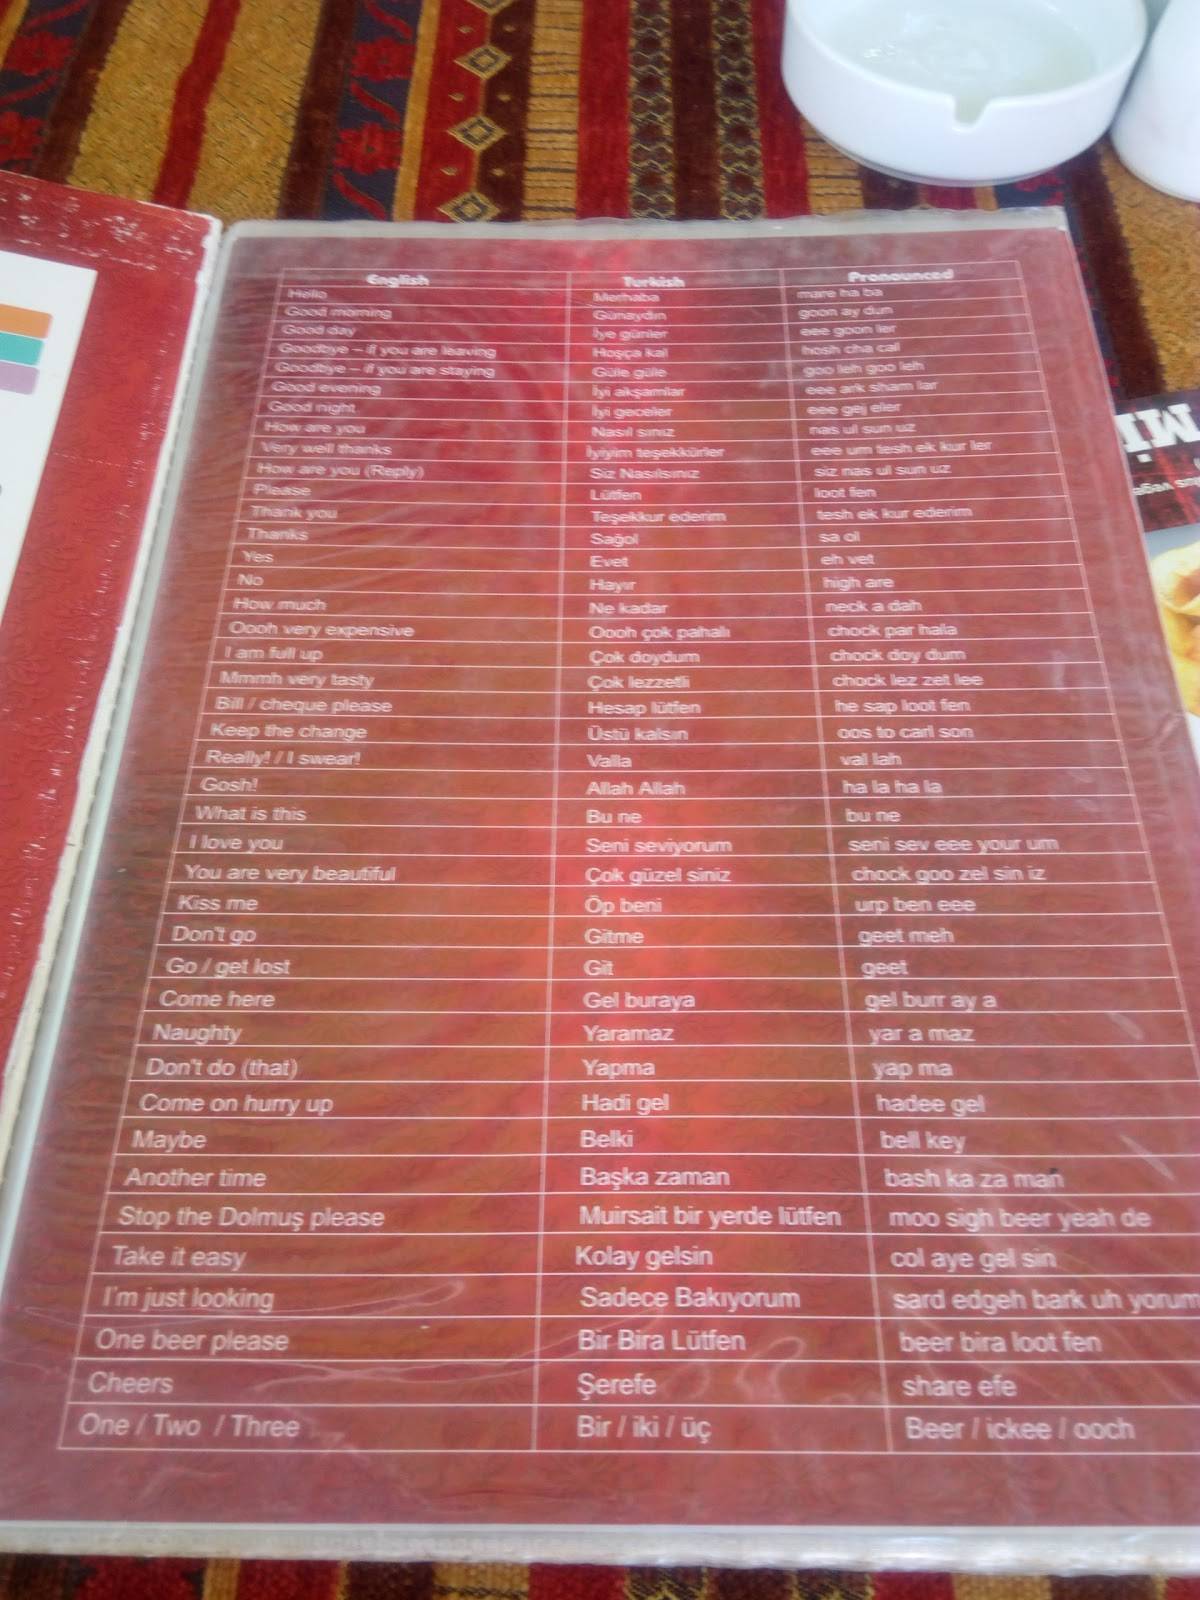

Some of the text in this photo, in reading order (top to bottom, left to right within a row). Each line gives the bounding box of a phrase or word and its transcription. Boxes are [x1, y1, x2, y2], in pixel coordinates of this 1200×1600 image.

[848, 268, 953, 283] Pronounced
[287, 288, 327, 300] Hello
[285, 306, 392, 320] Good morning
[282, 323, 356, 338] Good day
[271, 379, 381, 396] Good evening
[268, 399, 355, 415] Good night
[264, 420, 365, 436] How are you
[261, 441, 391, 456] Very well thanks
[257, 462, 423, 479] How are you (Reply)
[253, 482, 310, 497] Please
[251, 504, 337, 521] Thank you
[248, 526, 308, 542] Thanks
[243, 551, 274, 563] Yes
[236, 573, 264, 587] No
[823, 575, 894, 591] high are
[233, 596, 326, 612] How much
[229, 620, 414, 638] Oooh very expensive
[827, 623, 957, 638] chock par hala
[224, 645, 323, 662] I am full up
[220, 670, 374, 688] Mmmh very tasty
[211, 723, 367, 740] Keep the change
[200, 776, 257, 793] Gosh!
[586, 781, 685, 797] Allah Allah
[196, 805, 306, 822] What is this
[586, 808, 641, 825] Bu ne
[189, 834, 283, 851] I love you
[586, 837, 732, 854] Seni seviyorum
[185, 864, 395, 883] You are very beautiful
[585, 867, 730, 884] Çok güzel siniz
[178, 894, 258, 912] Kiss me
[585, 894, 662, 914] Öp beni
[172, 925, 256, 944] Don't go
[585, 928, 643, 945] Gitme
[858, 927, 953, 944] geet meh
[584, 959, 613, 977] Git
[862, 960, 908, 976] geet
[159, 989, 275, 1009] Come here
[583, 991, 695, 1010] Gel buraya
[153, 1023, 241, 1044] Naughty
[584, 1025, 673, 1043] Yaramaz
[145, 1057, 297, 1079] Don't do (that)
[583, 1059, 655, 1079] Yapma
[873, 1062, 953, 1079] yap ma
[140, 1093, 333, 1117] Come on hurry up
[582, 1093, 669, 1115] Hadi gel
[876, 1094, 985, 1116] hadee gel
[132, 1129, 206, 1153] Maybe
[580, 1129, 633, 1149] Belki
[124, 1168, 266, 1188] Another time
[580, 1166, 729, 1191] Başka zaman
[118, 1205, 384, 1232] Stop the Dolmuş please
[113, 1244, 245, 1273] Take it easy
[576, 1245, 712, 1272] Kolay gelsin
[103, 1287, 275, 1312] I'm just looking
[581, 1286, 799, 1313] Sadece Bakıyorum
[95, 1326, 288, 1354] One beer please
[578, 1328, 745, 1352] Bir Bira Lütfen
[88, 1371, 173, 1395] Cheers
[577, 1373, 656, 1400] Şerefe
[903, 1373, 1016, 1398] share efe
